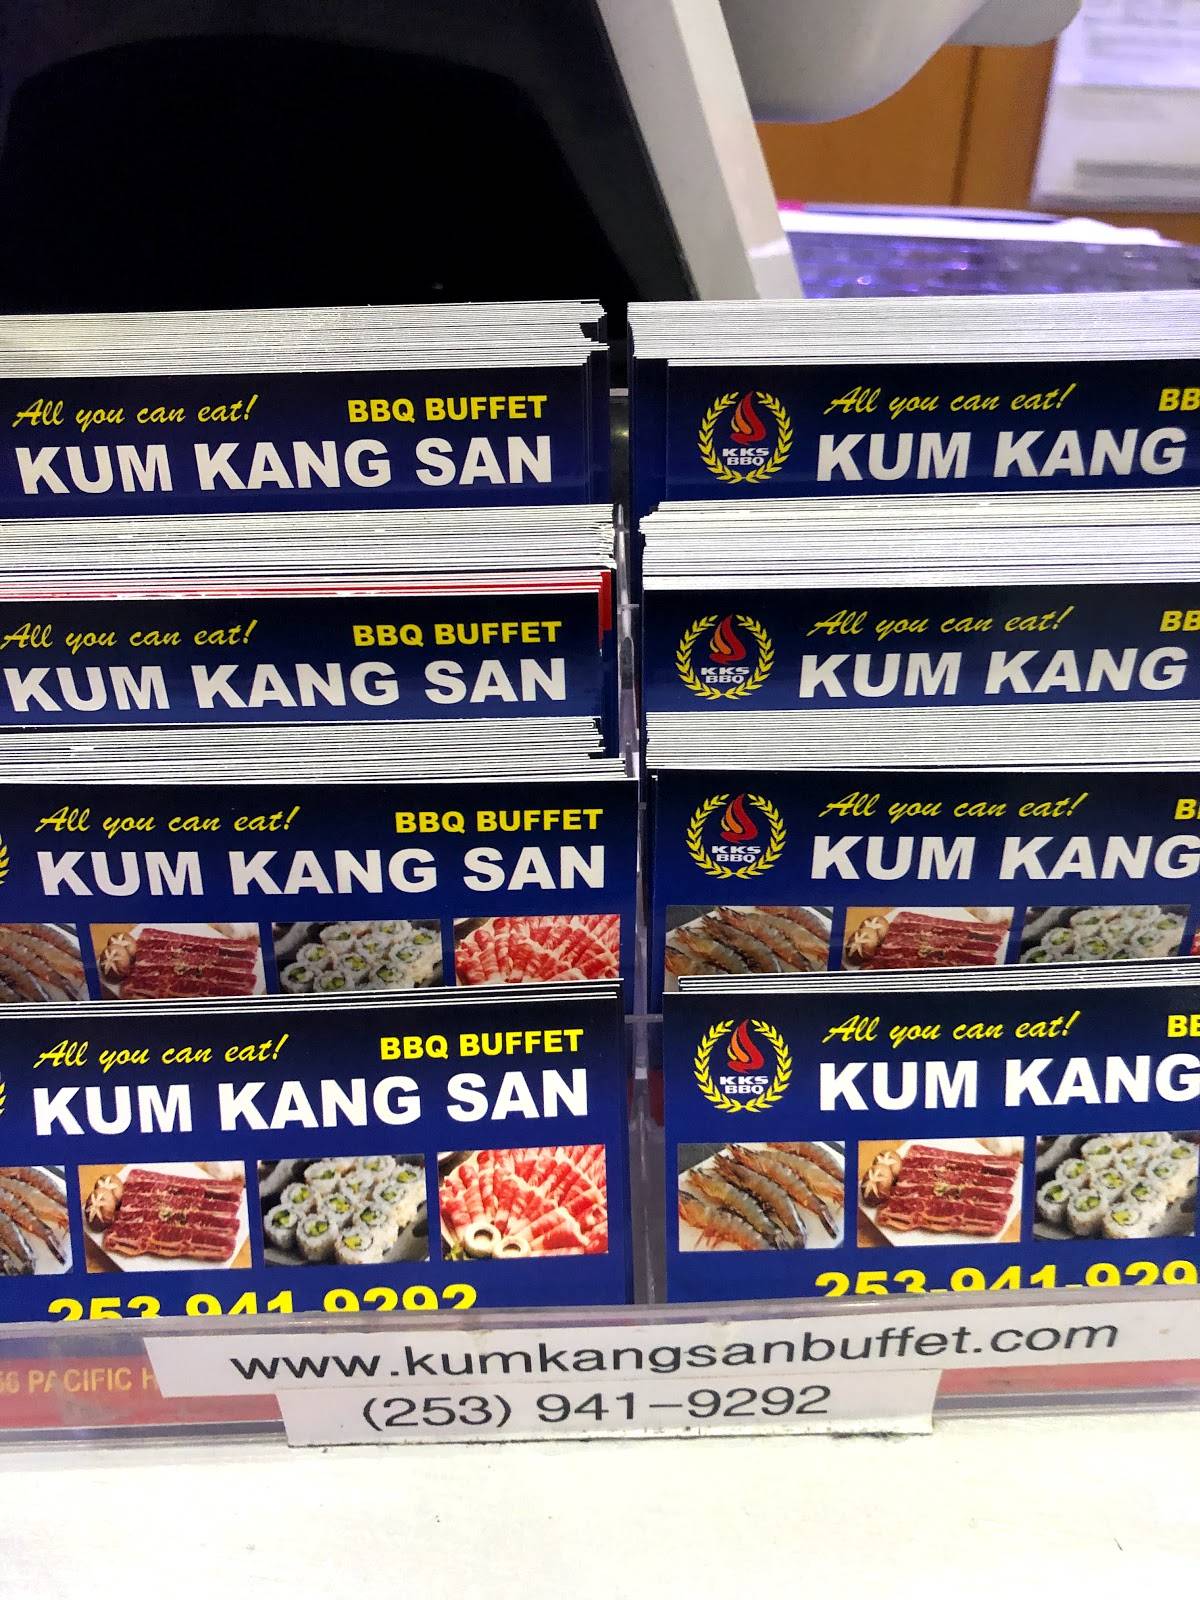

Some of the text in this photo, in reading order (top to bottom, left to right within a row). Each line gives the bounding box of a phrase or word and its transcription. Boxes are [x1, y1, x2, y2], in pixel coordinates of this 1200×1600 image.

[12, 394, 258, 431] All you can eat!
[347, 394, 548, 423] BBQ BUFFET
[825, 383, 1077, 419] All you can eat!
[15, 435, 552, 495] KUM KANG SAN
[722, 447, 770, 457] KKS
[726, 456, 765, 467] BBQ
[816, 427, 1187, 482] KUM KANG
[0, 619, 258, 654] All you can eat!
[352, 620, 562, 647] BBQ BUFFET
[806, 607, 1073, 640] All you can eat!
[3, 657, 567, 712] KUM KANG SAN
[700, 666, 750, 676] KKS
[705, 674, 745, 684] BBQ
[799, 646, 1188, 699] KUM KANG
[35, 805, 301, 839] All you can eat!
[394, 808, 604, 834] BBQ BUFFET
[819, 791, 1089, 823] All you can eat!
[711, 845, 761, 856] KKS
[716, 854, 756, 864] BBQ
[810, 834, 1200, 881] KUM KANG
[36, 845, 605, 897] KUM KANG SAN
[380, 1028, 584, 1061] BBQ BUFFET
[822, 1010, 1081, 1049] All you can eat!
[33, 1033, 289, 1073] All you can eat!
[719, 1075, 769, 1087] KKS
[724, 1085, 765, 1096] BBQ
[819, 1053, 1200, 1111] KUM KANG
[32, 1068, 588, 1136] KUM KANG SAN
[230, 1320, 1119, 1380] www.kumkangsanbuffet.com
[362, 1385, 832, 1431] (253) 941-9292
